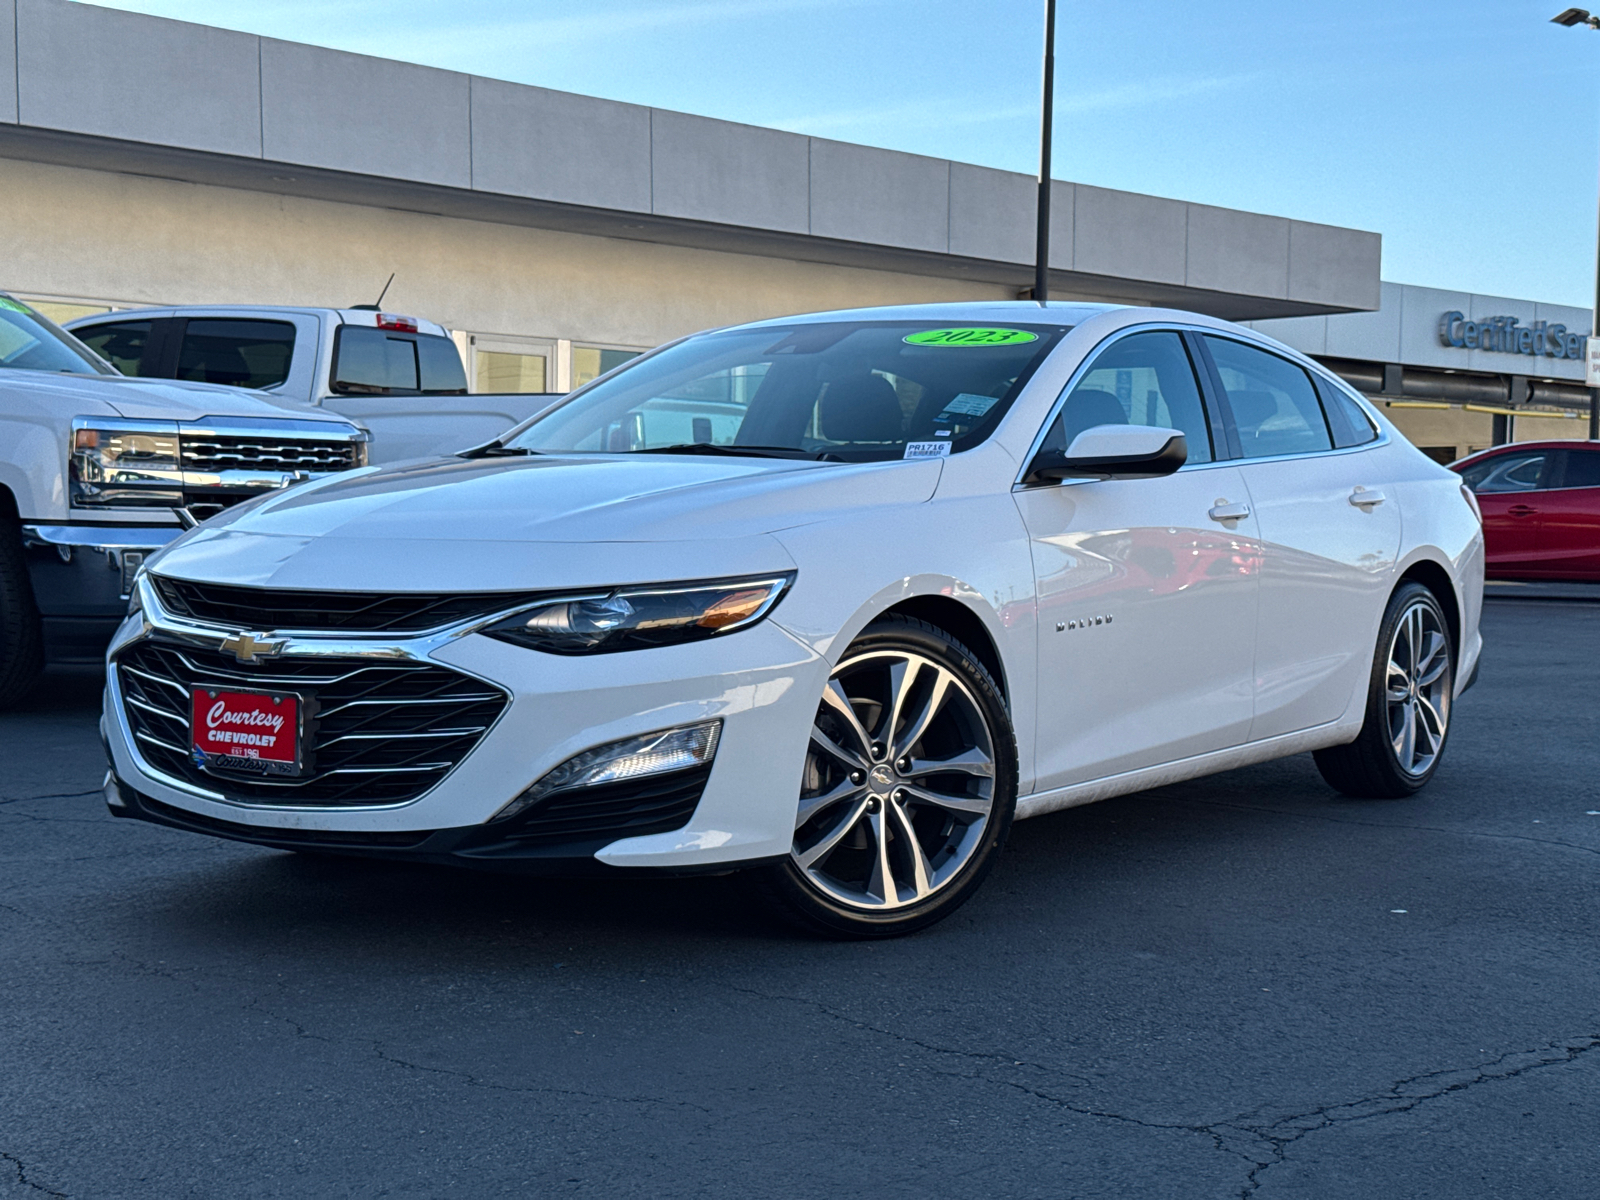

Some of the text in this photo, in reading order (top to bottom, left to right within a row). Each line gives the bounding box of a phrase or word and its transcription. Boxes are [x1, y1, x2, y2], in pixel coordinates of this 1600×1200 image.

[920, 331, 1019, 342] 2023
[908, 443, 945, 451] PR1716
[1056, 614, 1113, 632] MALIBU
[206, 701, 285, 734] Courtesy
[207, 730, 277, 748] CHEVROLET
[215, 753, 269, 772] Courtesy
[244, 748, 260, 759] 1961
